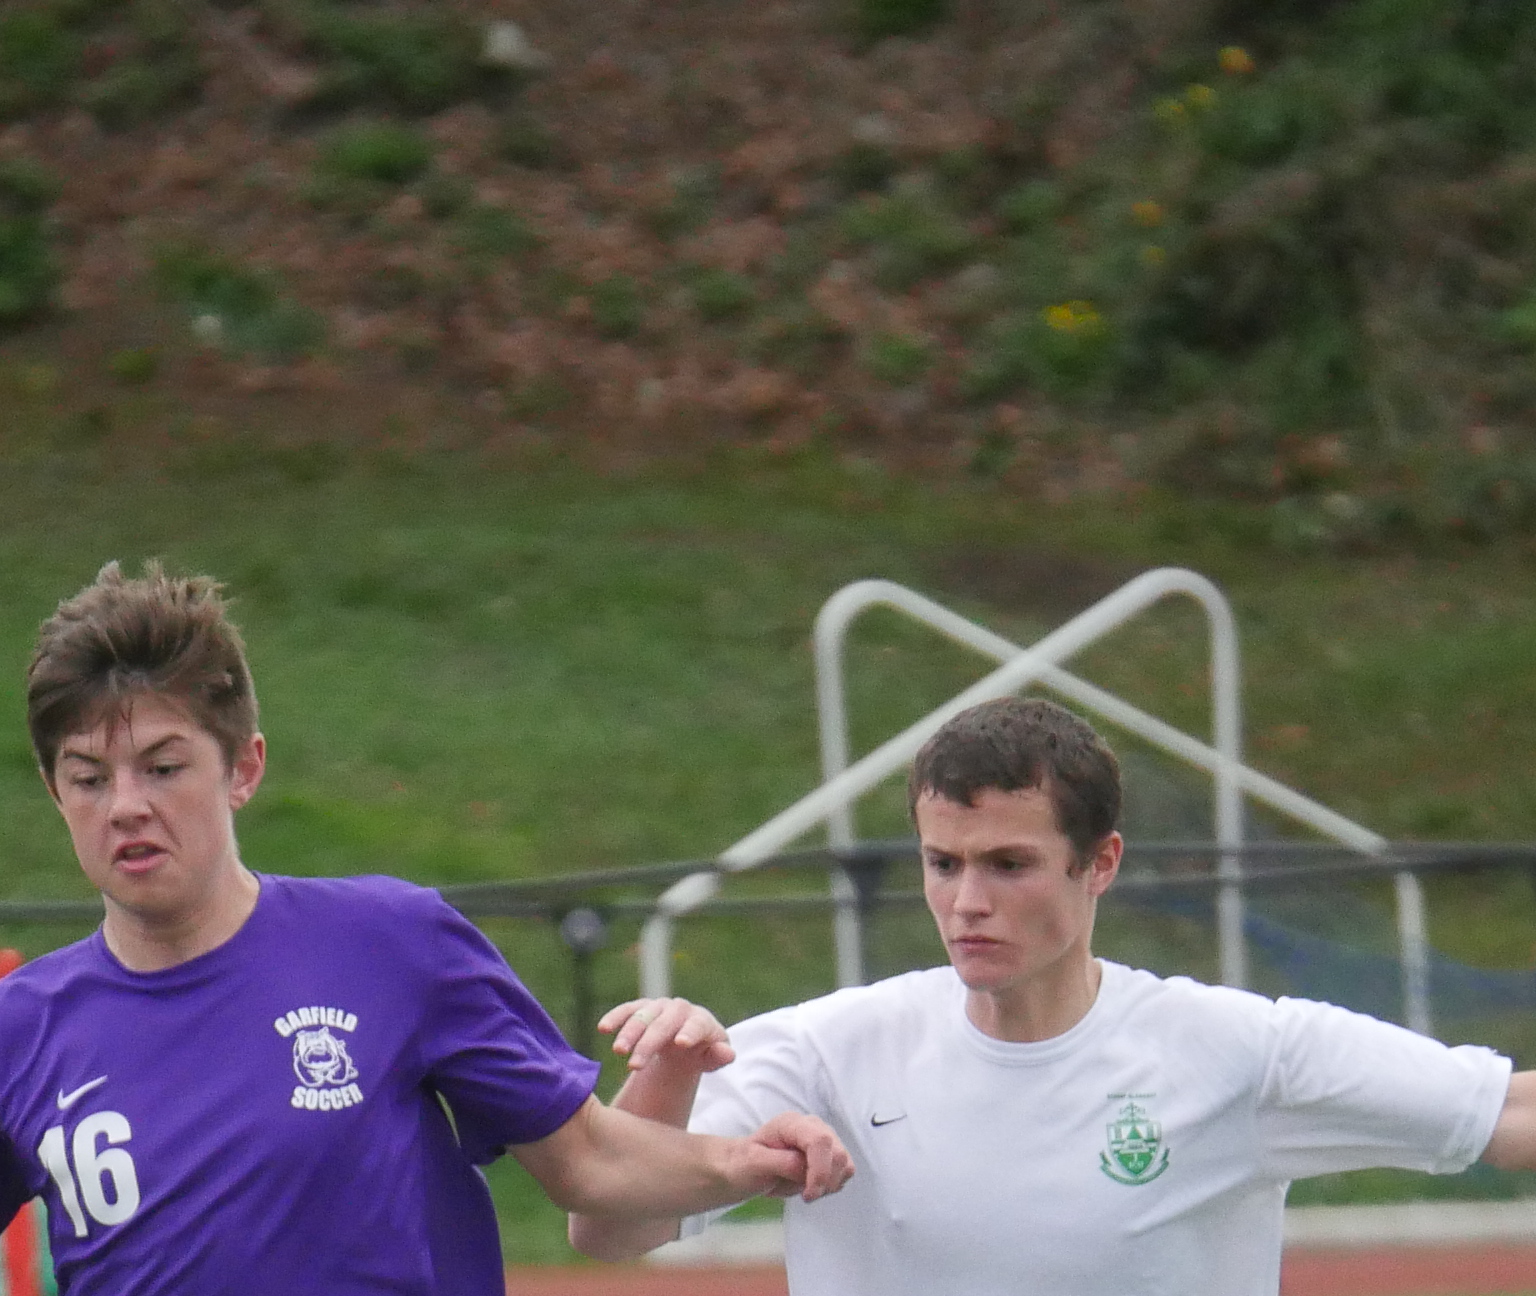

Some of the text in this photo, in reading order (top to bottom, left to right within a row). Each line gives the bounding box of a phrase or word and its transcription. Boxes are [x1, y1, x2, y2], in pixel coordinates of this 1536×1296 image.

[273, 1005, 359, 1038] GARFIELD
[290, 1082, 364, 1112] SOCCER
[37, 1110, 141, 1238] 16
